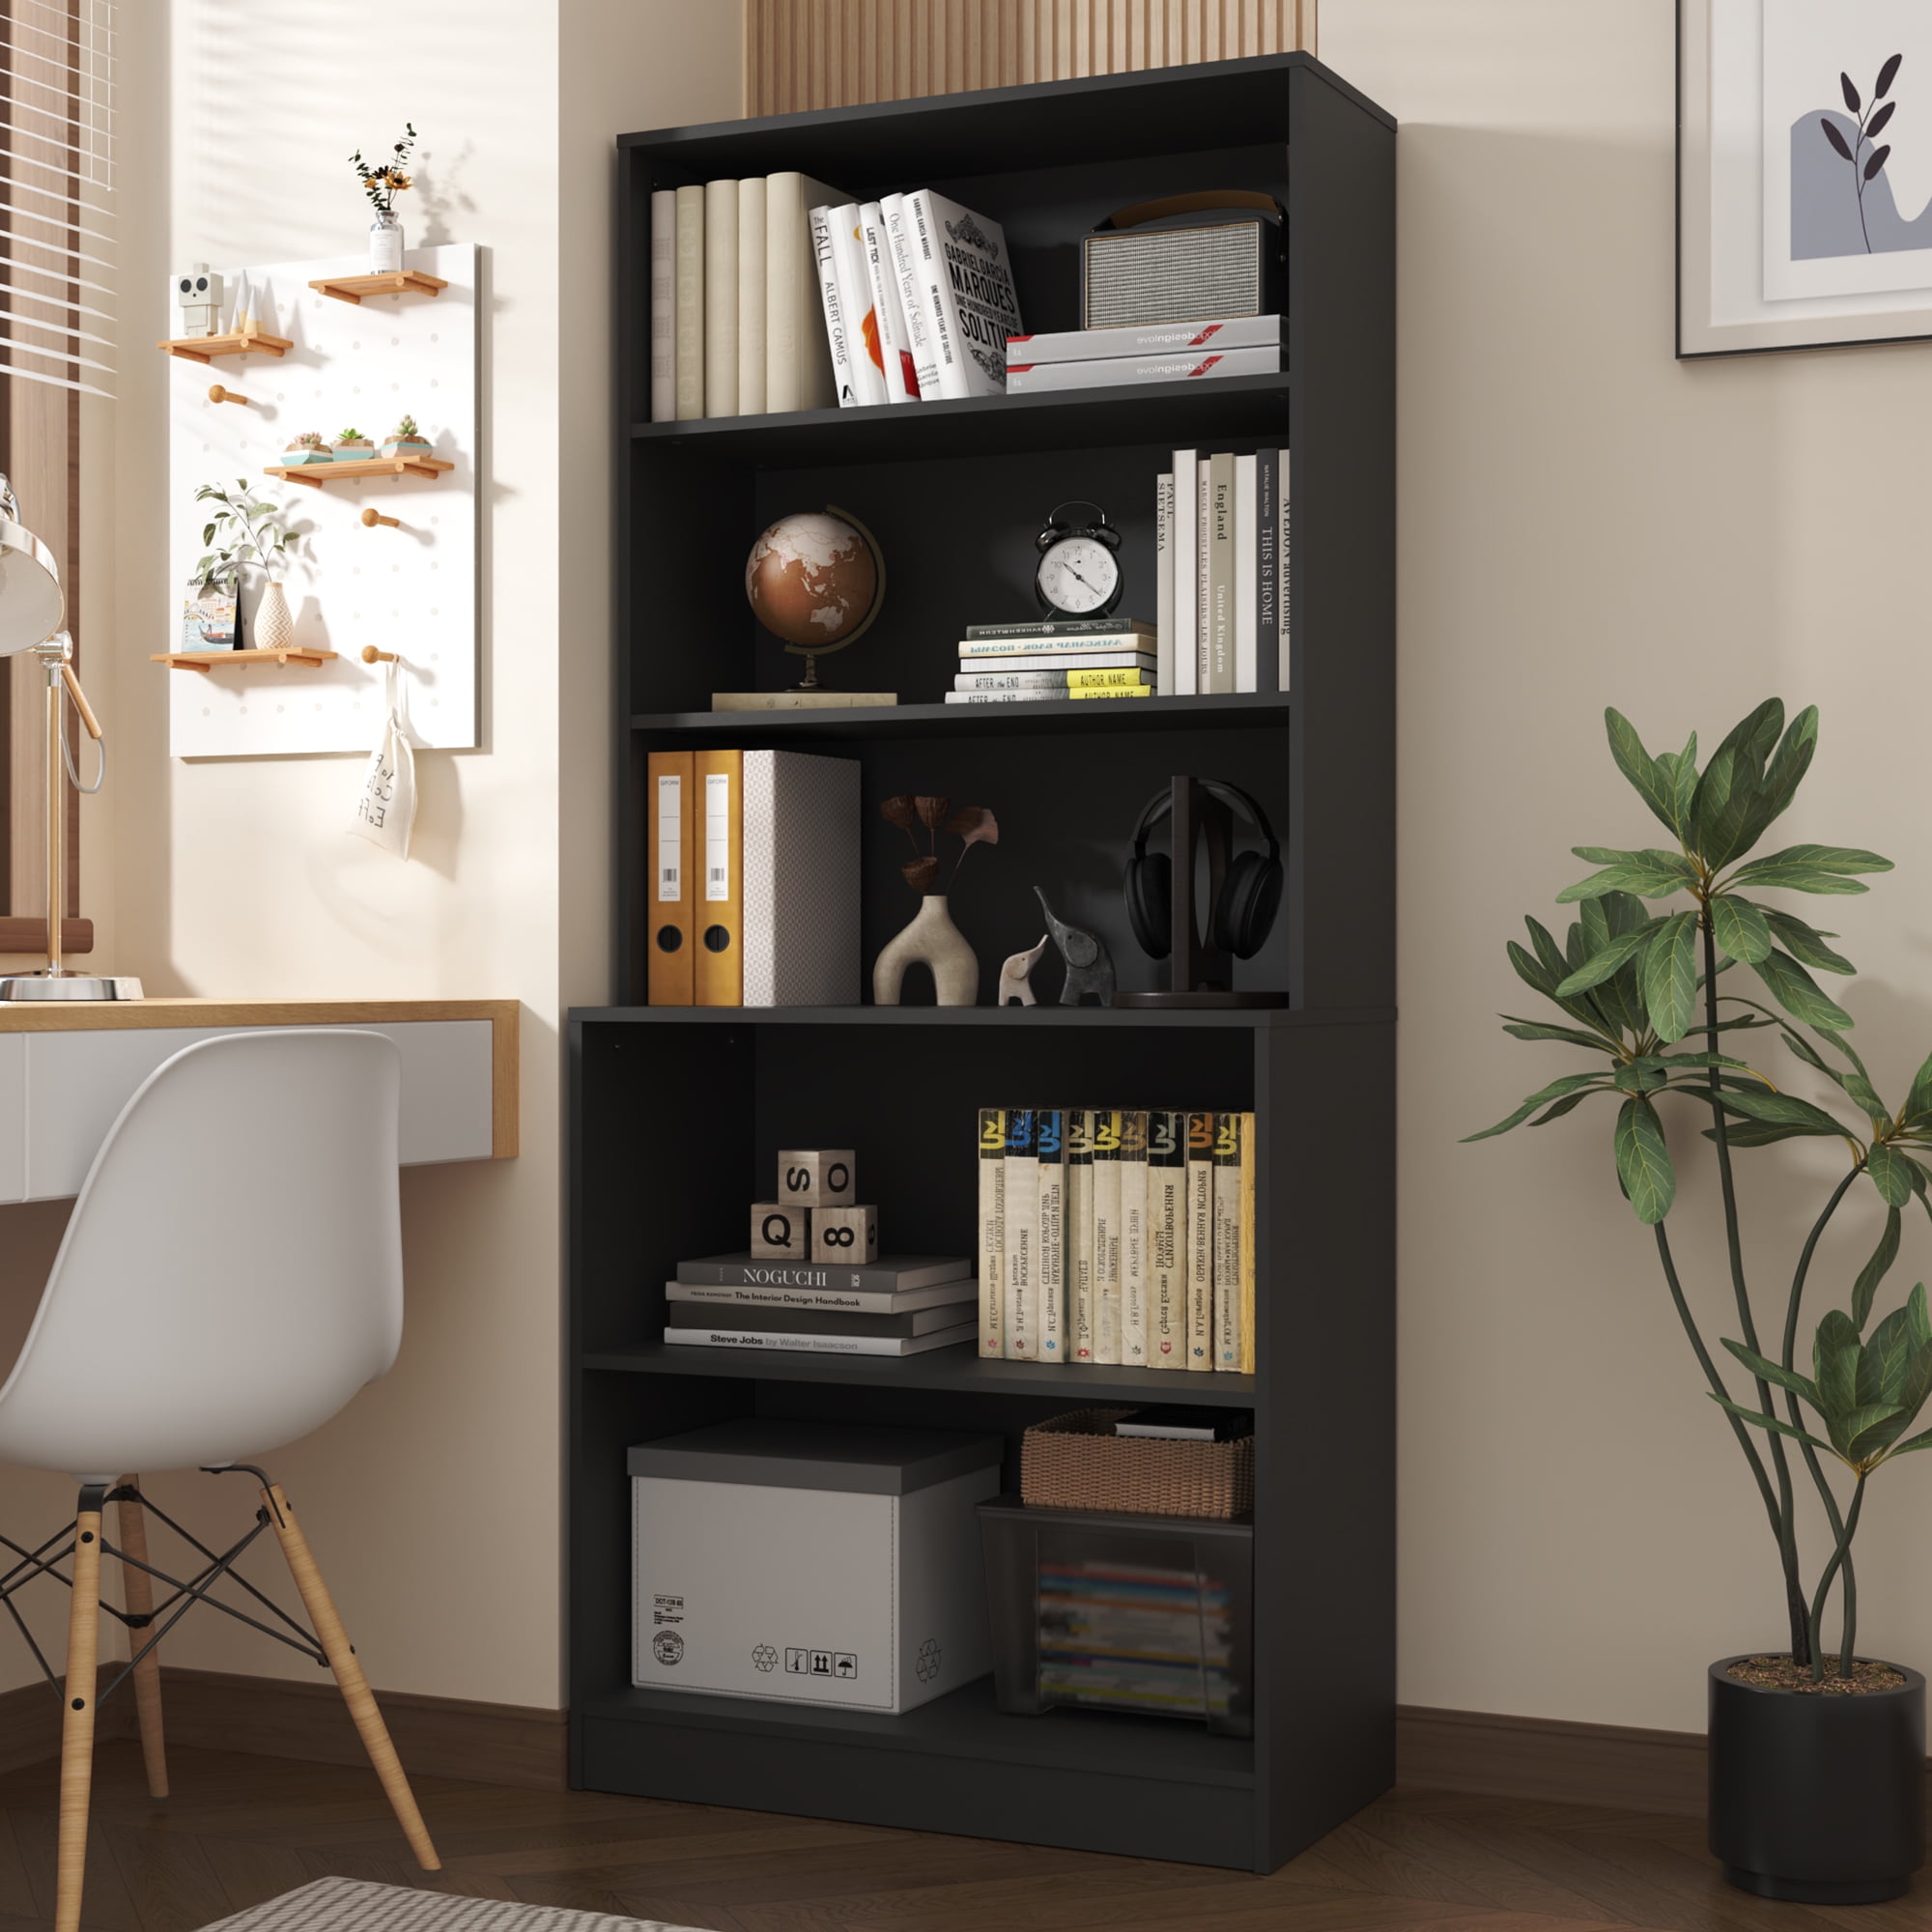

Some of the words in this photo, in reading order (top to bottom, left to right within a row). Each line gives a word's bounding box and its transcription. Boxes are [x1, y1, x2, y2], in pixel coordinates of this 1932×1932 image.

[866, 227, 876, 245] LAST
[889, 213, 898, 234] One
[814, 225, 833, 267] FALL
[893, 230, 909, 272] Hundred
[945, 242, 980, 272] GABRIEL
[899, 270, 912, 299] Years
[825, 282, 840, 323] ALBERT
[906, 299, 916, 310] of
[909, 308, 923, 348] Solitude
[958, 308, 1020, 353] SOLITU
[832, 327, 847, 365] CAMUS
[1215, 484, 1227, 541] England
[1262, 526, 1273, 560] THIS
[1262, 564, 1273, 577] IS
[1217, 585, 1226, 621] United
[1262, 581, 1273, 625] HOME
[1216, 625, 1226, 673] Kingdom
[976, 677, 994, 689] AFTER
[1007, 676, 1019, 688] END
[1080, 674, 1104, 686] AUTHOR
[1108, 673, 1126, 685] NAME
[786, 1167, 810, 1192] S
[762, 1214, 791, 1248] Q
[823, 1227, 854, 1247] 8
[743, 1268, 827, 1287] NOGUCHI
[735, 1292, 751, 1300] The
[752, 1293, 782, 1302] Interior
[784, 1294, 813, 1304] Design
[815, 1297, 861, 1307] Handbook
[710, 1334, 738, 1344] Steve
[739, 1336, 763, 1345] Jobs
[766, 1337, 778, 1347] by
[780, 1338, 810, 1348] Walter
[813, 1340, 858, 1350] Isaacson
